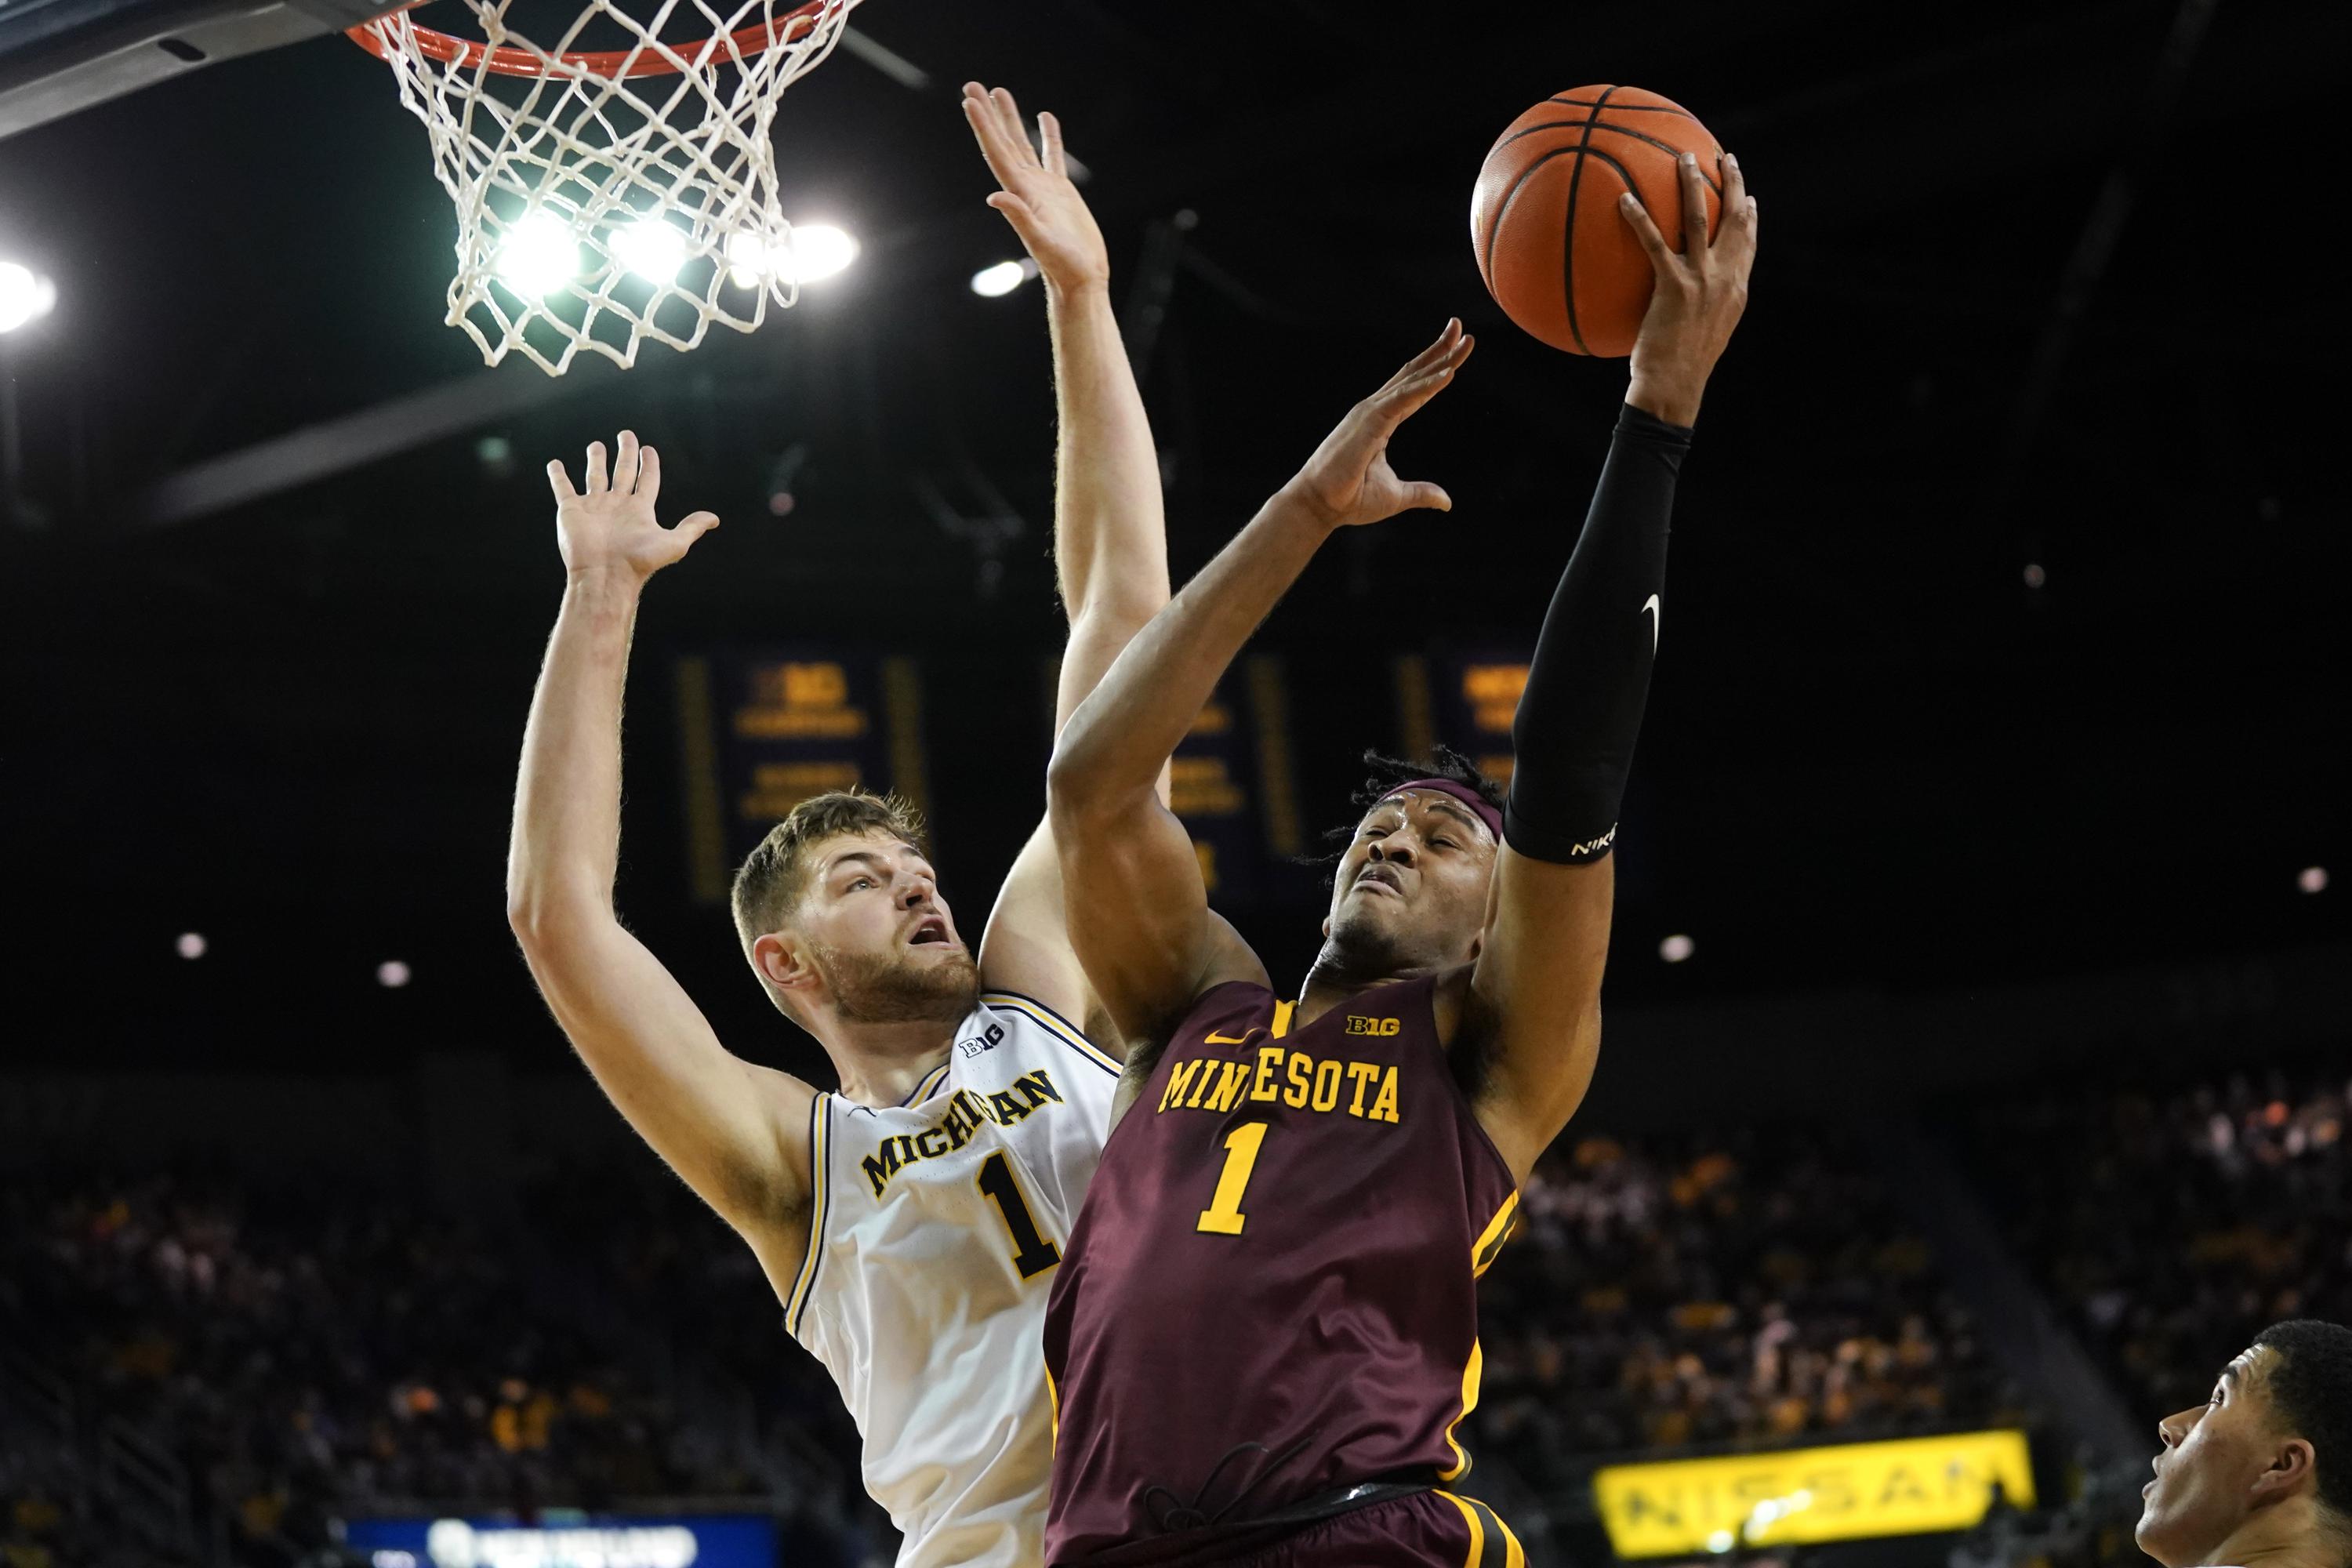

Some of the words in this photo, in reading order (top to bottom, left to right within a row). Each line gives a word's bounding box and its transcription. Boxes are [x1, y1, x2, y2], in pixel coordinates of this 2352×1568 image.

[1157, 1047, 1400, 1124] MINESOTA
[976, 1149, 1062, 1281] 1
[1196, 1122, 1269, 1235] 1
